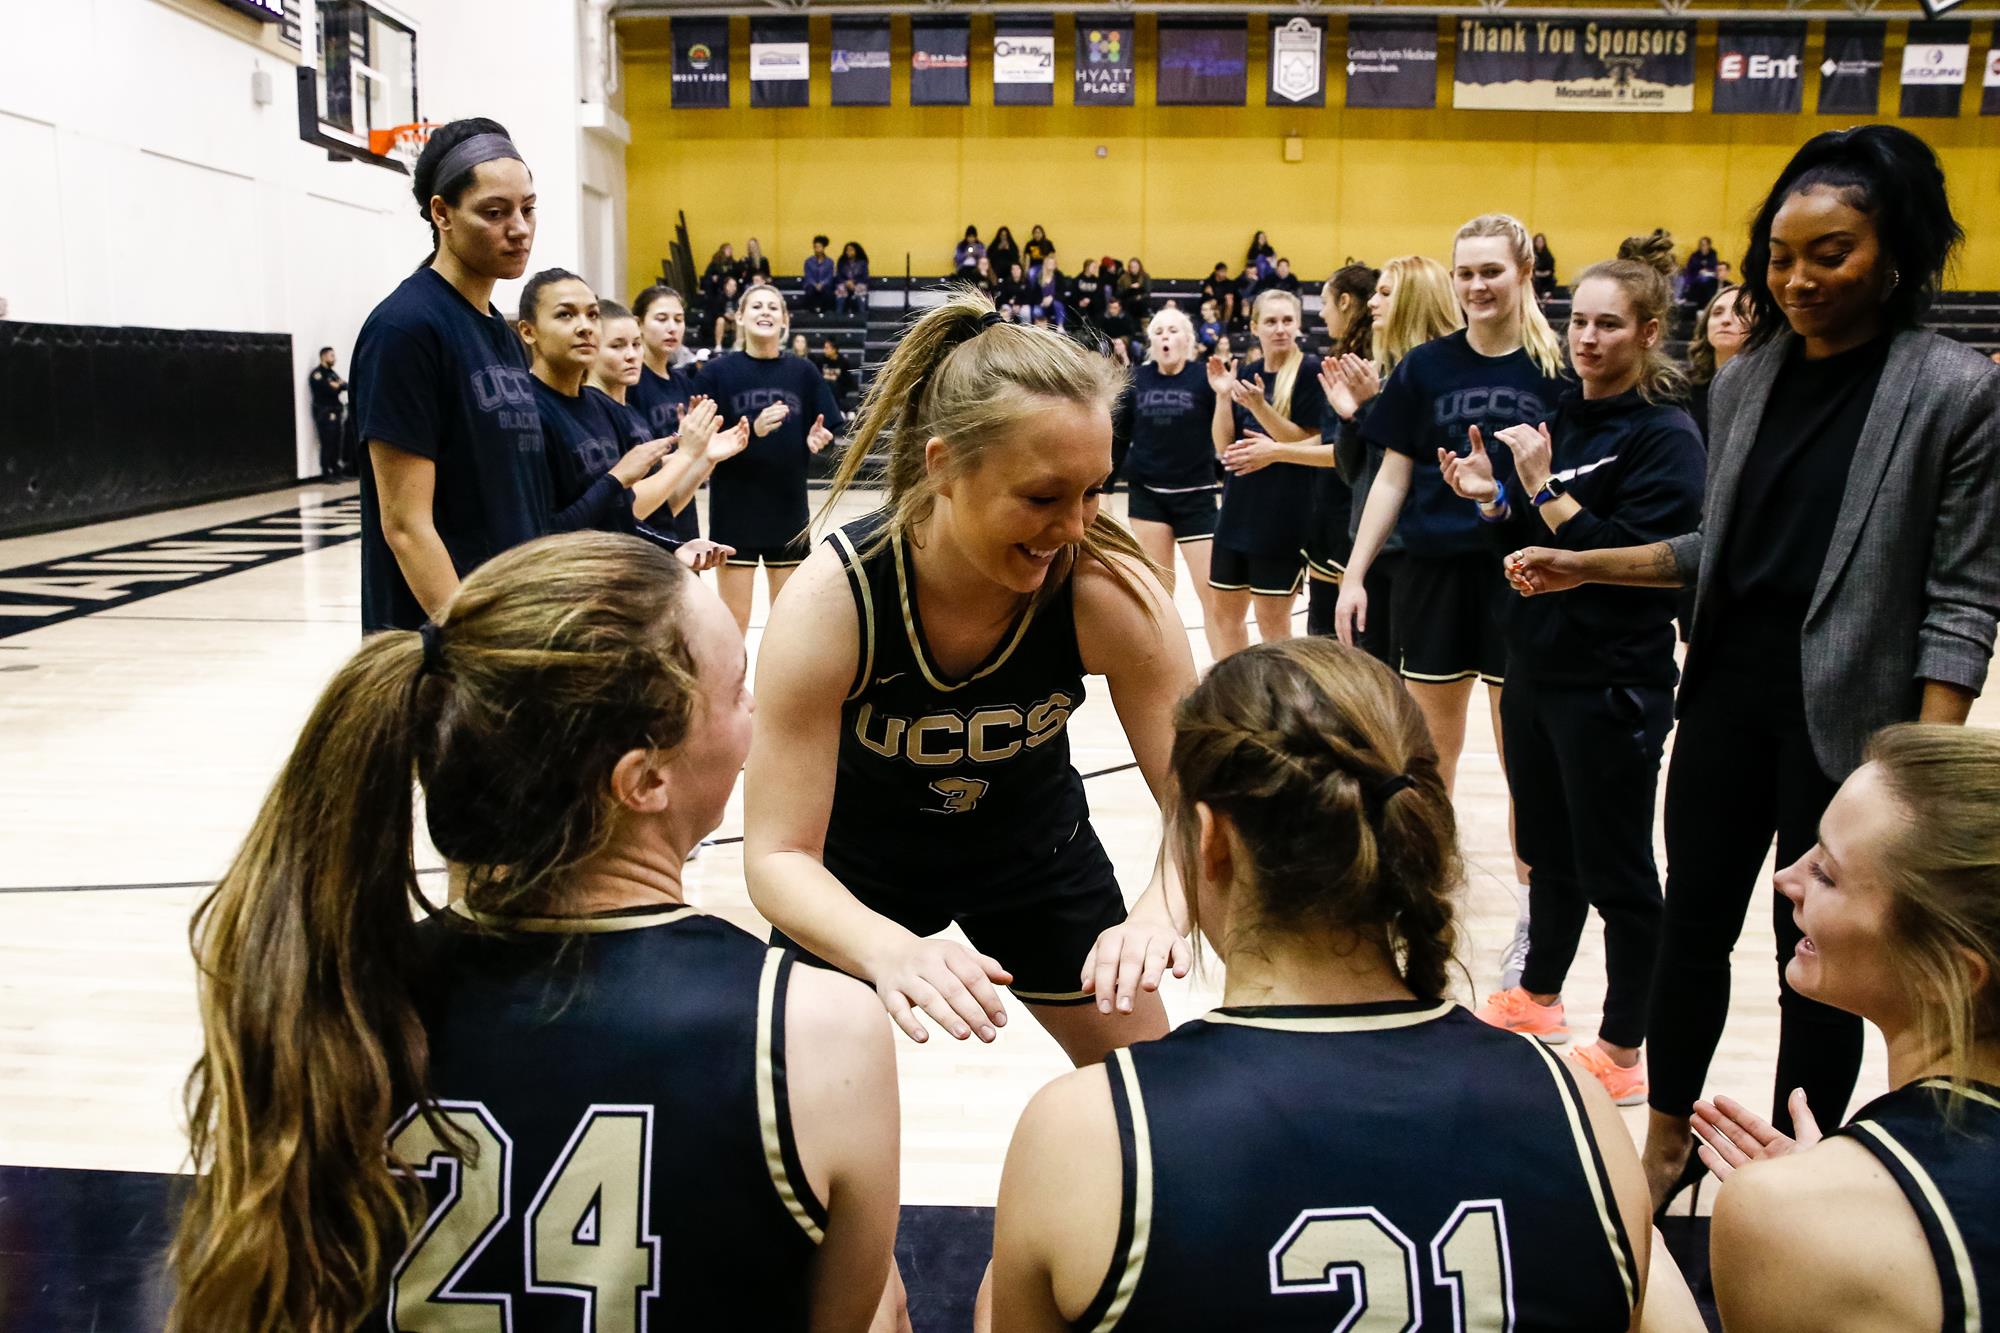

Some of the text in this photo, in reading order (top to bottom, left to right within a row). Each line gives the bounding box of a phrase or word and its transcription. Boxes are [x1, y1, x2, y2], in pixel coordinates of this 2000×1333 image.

[1461, 19, 1687, 61] Thank You Sponsors
[1075, 68, 1132, 82] HYATT
[1748, 54, 1801, 79] Ent
[1083, 82, 1126, 94] PLACE
[1555, 86, 1664, 99] Mountain Lions
[470, 364, 537, 412] UCC
[1136, 388, 1195, 410] UCCS
[1434, 386, 1547, 426] UCCS
[855, 690, 1073, 768] UCCS
[920, 776, 989, 815] 3
[384, 1099, 661, 1333] 24
[1268, 1198, 1516, 1333] 21
